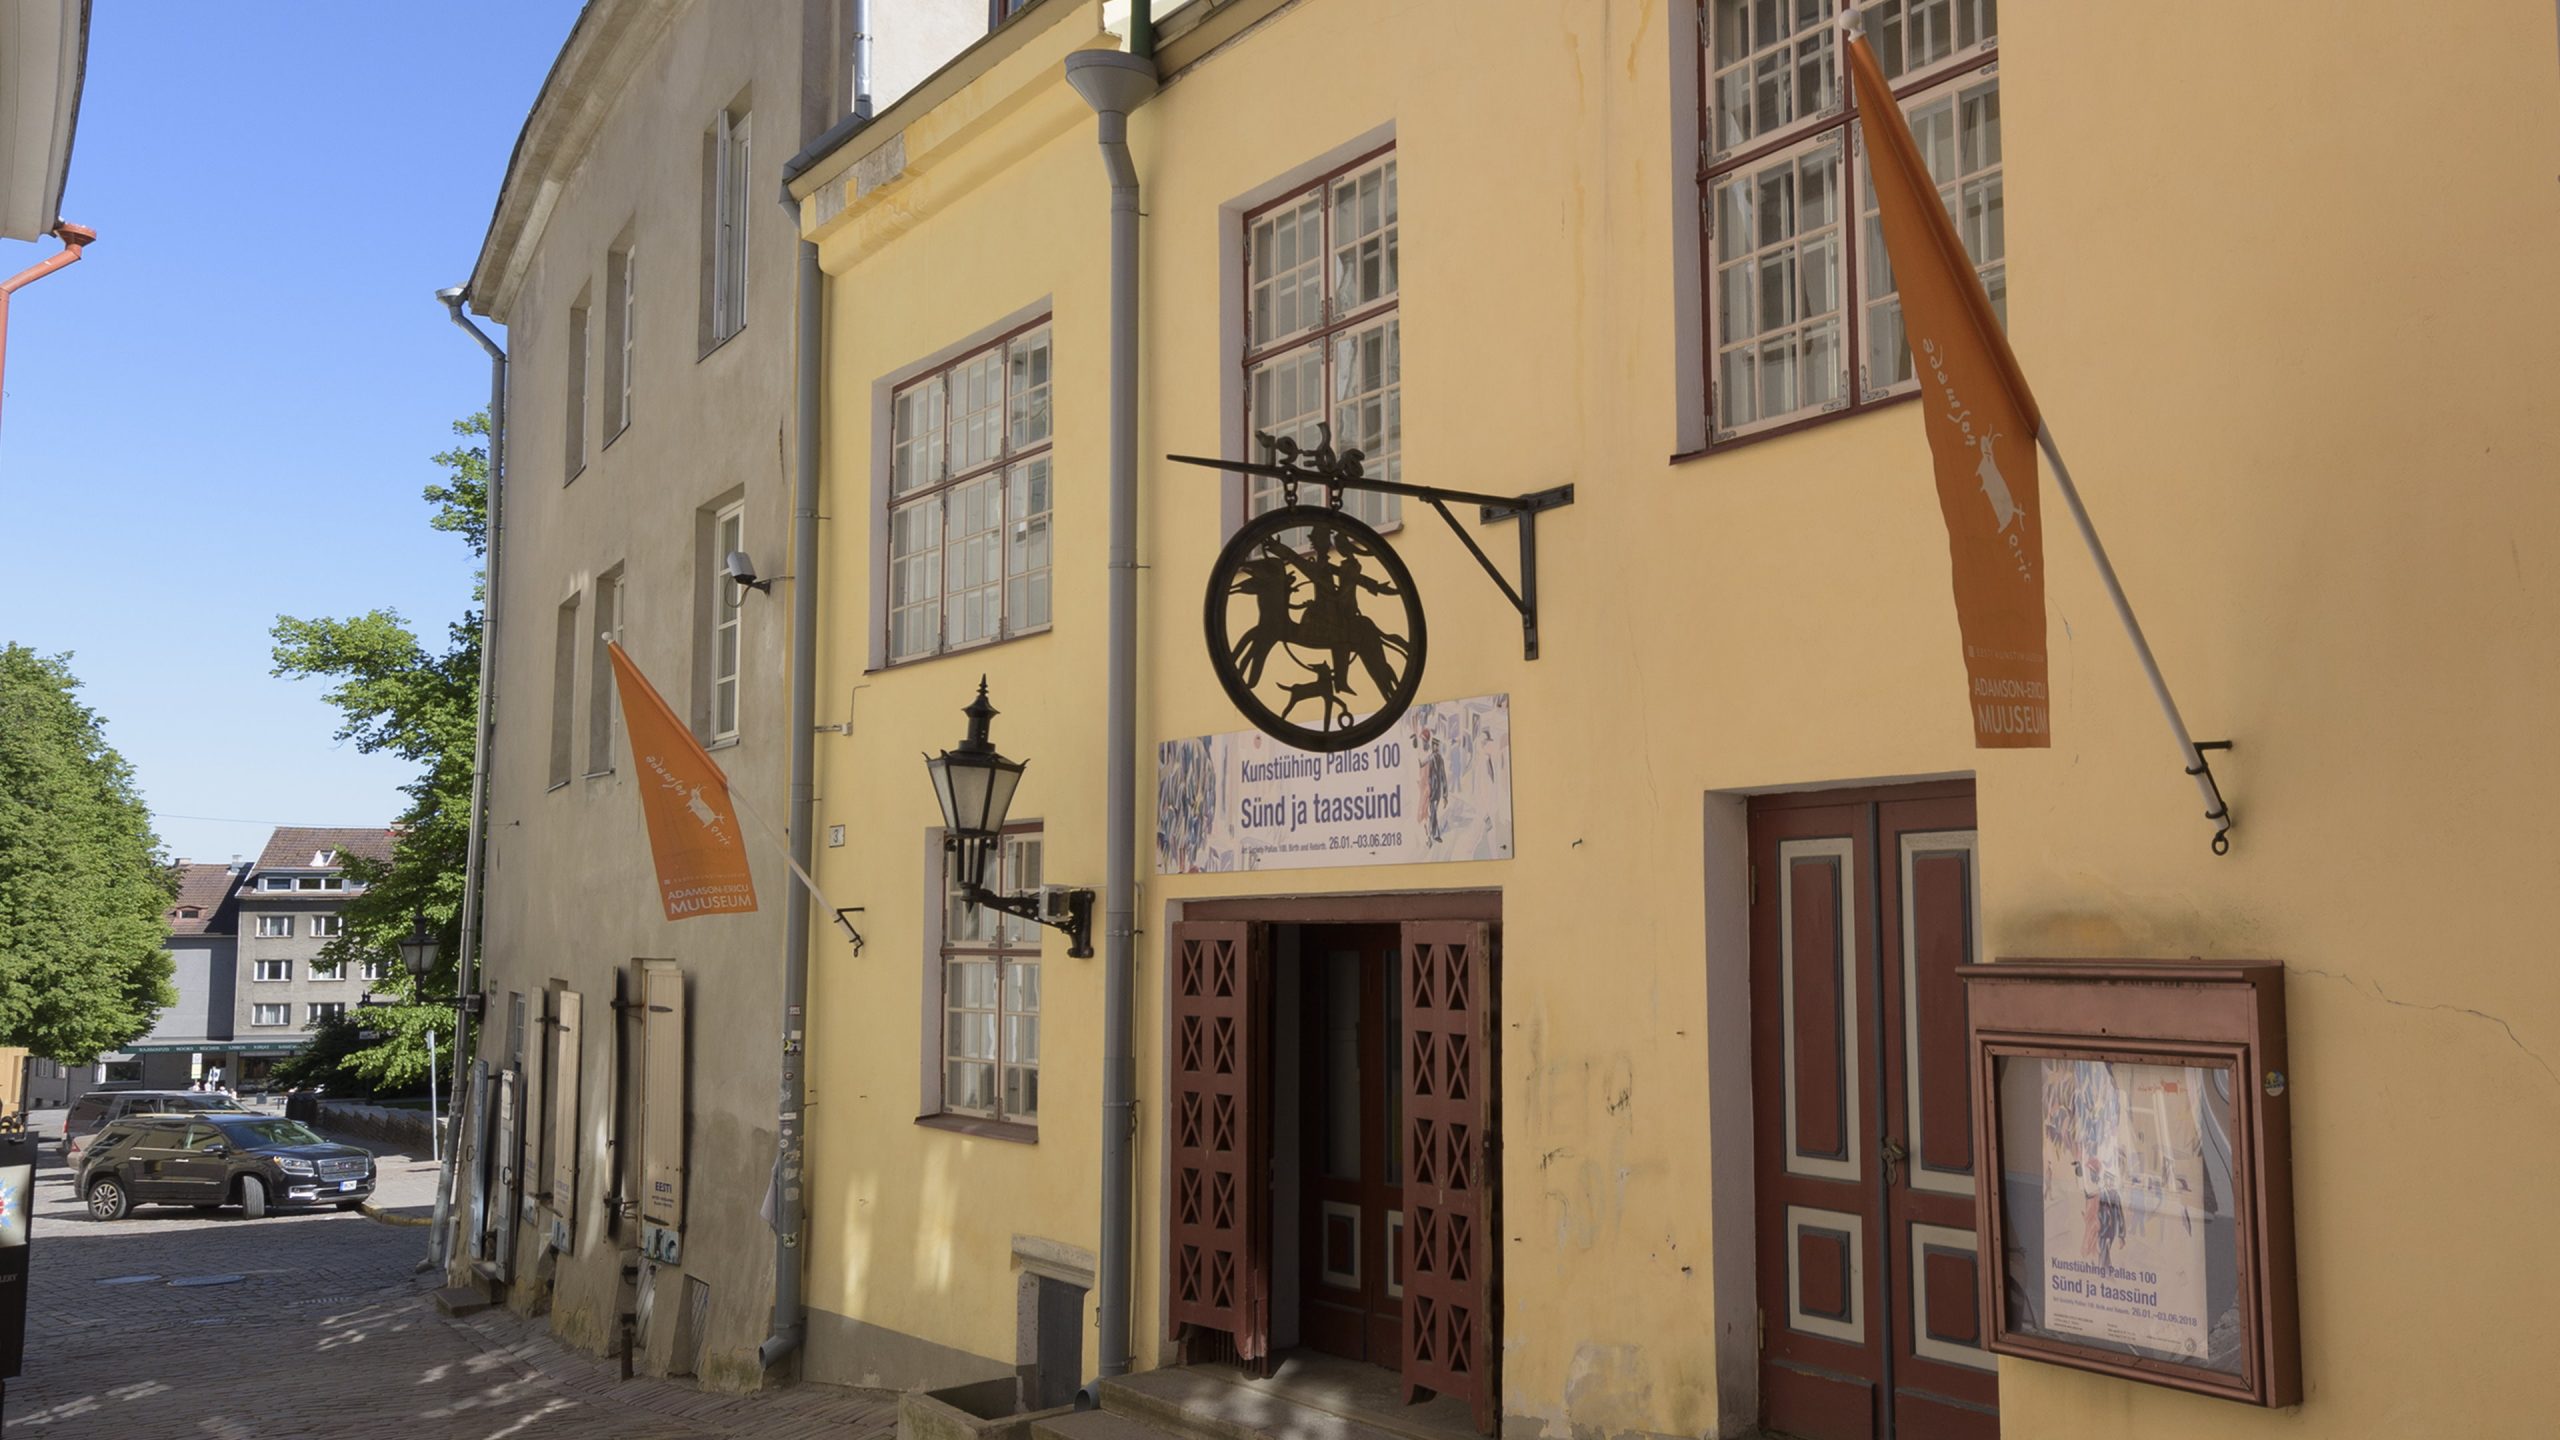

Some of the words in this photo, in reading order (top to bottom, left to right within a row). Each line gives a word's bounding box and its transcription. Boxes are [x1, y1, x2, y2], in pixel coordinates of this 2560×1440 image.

[1978, 704, 2049, 735] MUUSEUM
[1241, 754, 1321, 783] Kunstiühing
[1326, 750, 1369, 775] Pallas
[1374, 742, 1400, 769] 100
[1241, 795, 1285, 829] Sünd
[1290, 794, 1307, 832] ja
[1313, 784, 1401, 823] taassünd
[671, 894, 752, 914] MUUSEUM
[2051, 1257, 2106, 1278] Kunstiühing
[2108, 1266, 2136, 1283] Pallas
[2139, 1271, 2157, 1285] 100
[2052, 1275, 2082, 1294] Sünd
[2085, 1280, 2097, 1298] ja
[2100, 1284, 2158, 1307] taassünd
